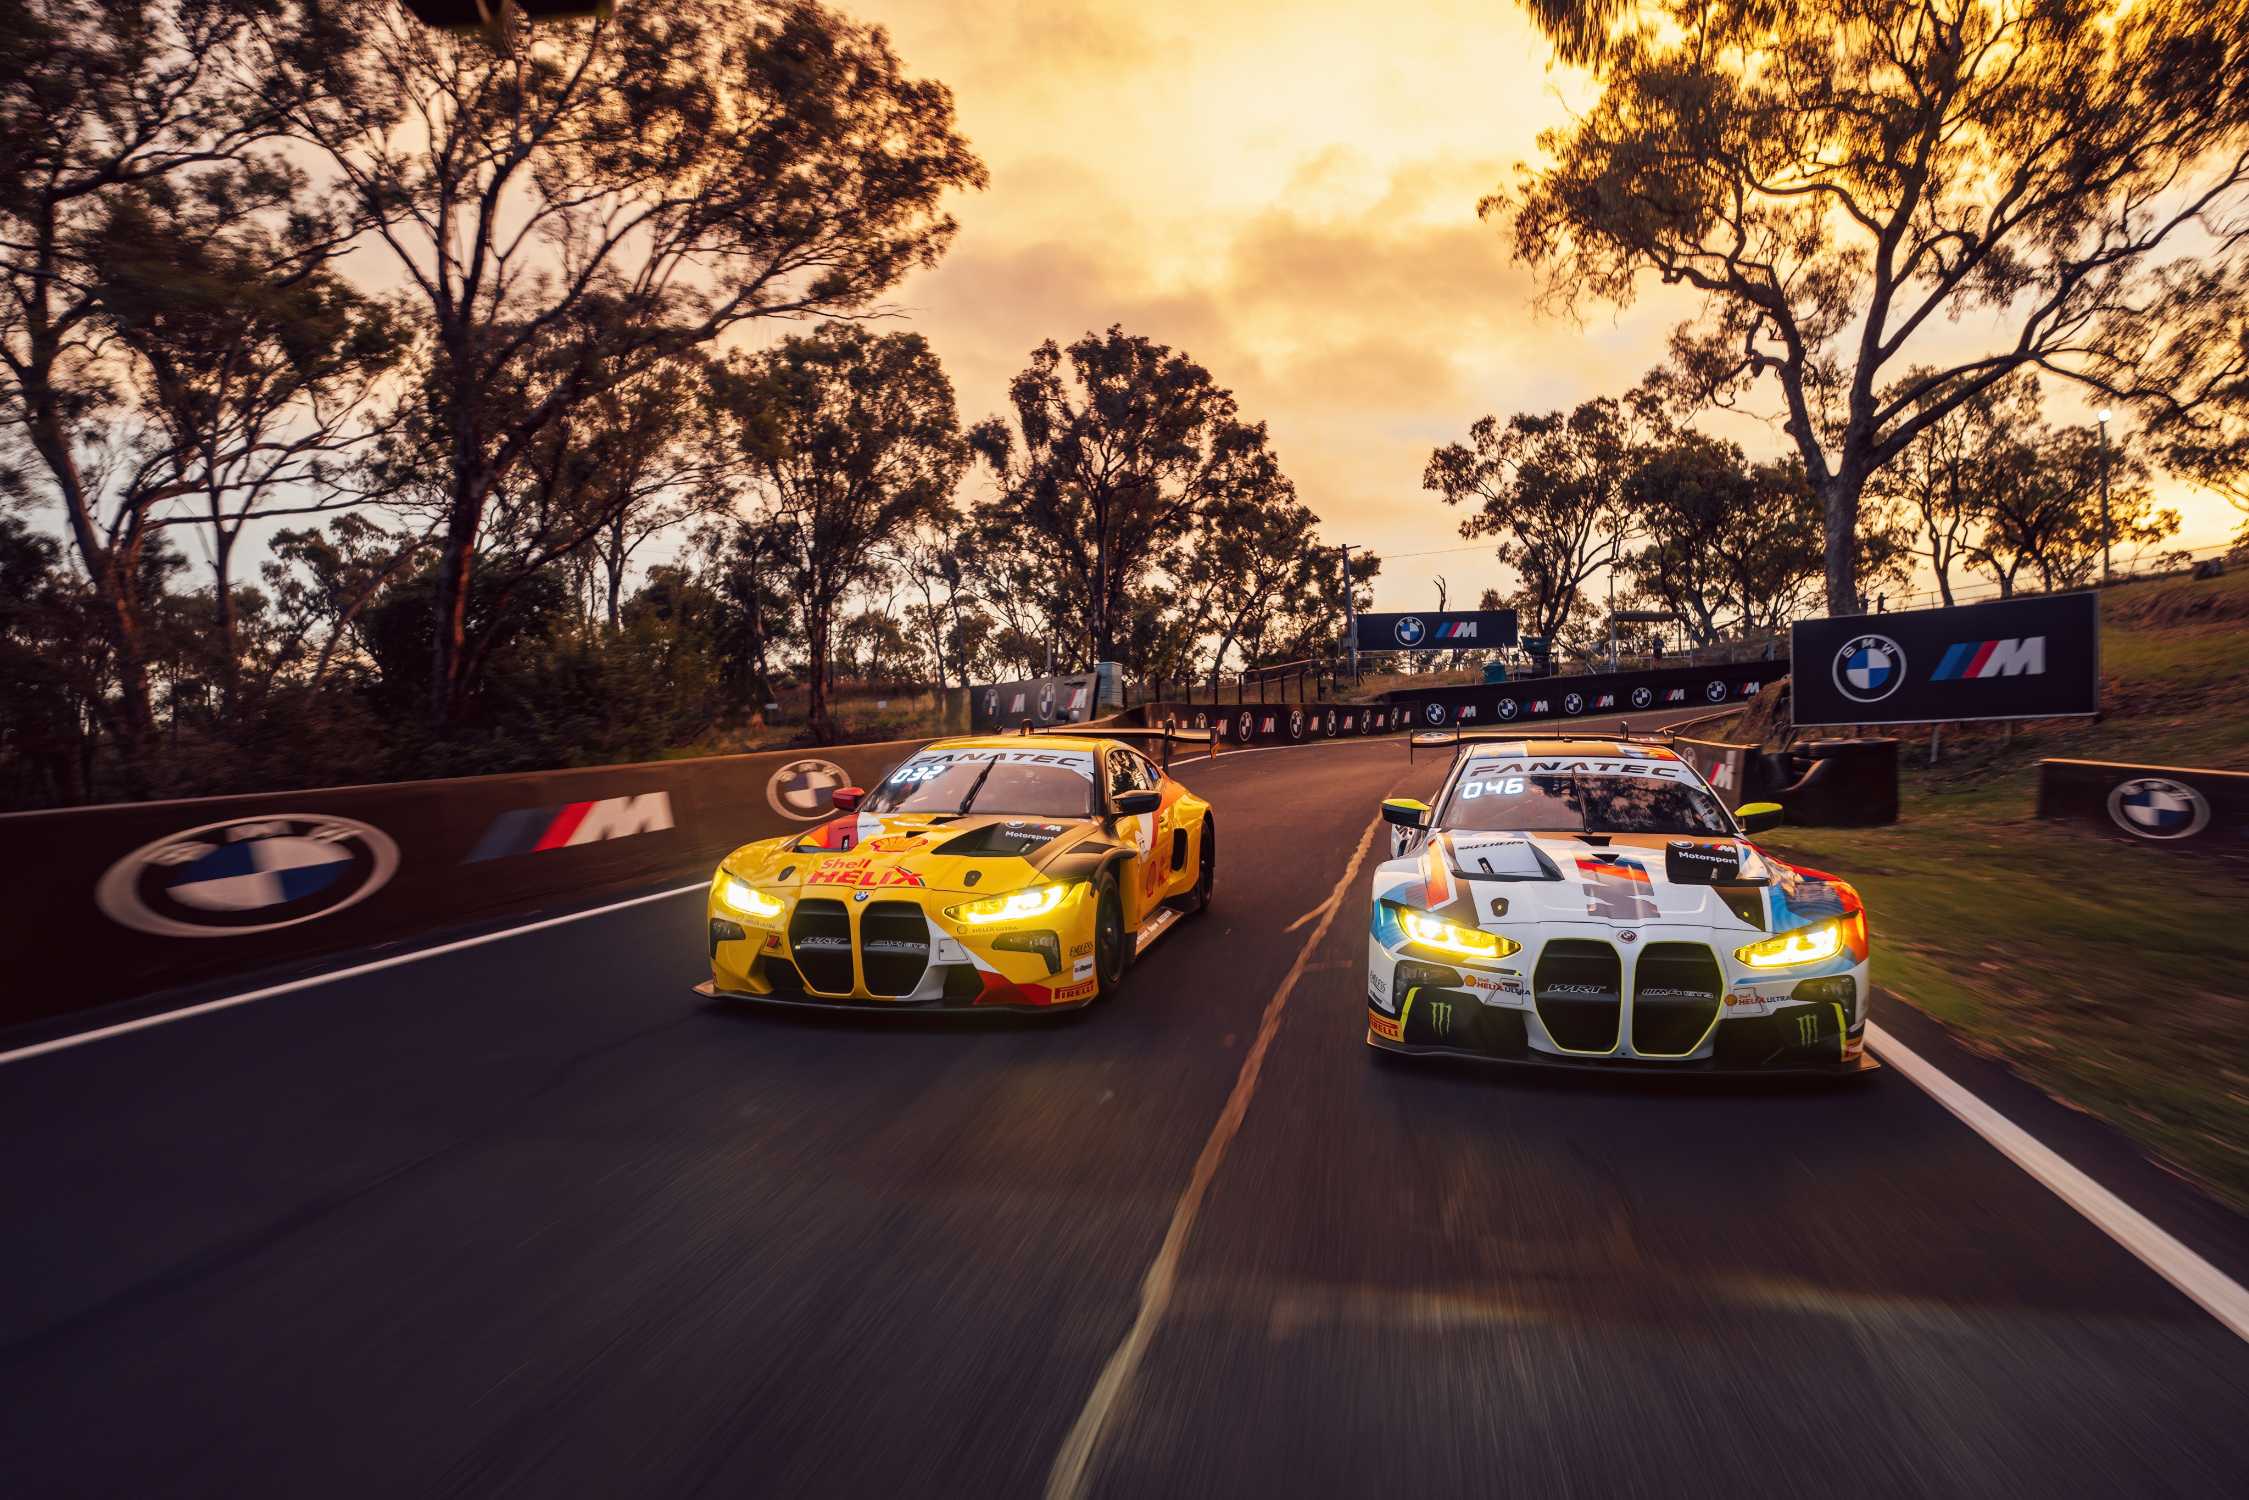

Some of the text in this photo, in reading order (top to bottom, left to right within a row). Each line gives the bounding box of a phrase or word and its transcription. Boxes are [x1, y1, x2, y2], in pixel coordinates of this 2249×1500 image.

[1843, 638, 1895, 658] BMW
[911, 753, 1084, 767] FANATEC
[891, 765, 945, 784] 032
[1470, 762, 1679, 777] FANATEC
[1462, 778, 1524, 800] 046
[1005, 831, 1055, 841] Motorsport
[821, 858, 872, 869] Shell
[1679, 851, 1738, 864] Motorsport
[808, 866, 925, 887] HELIX
[1055, 981, 1094, 999] PIRELLI
